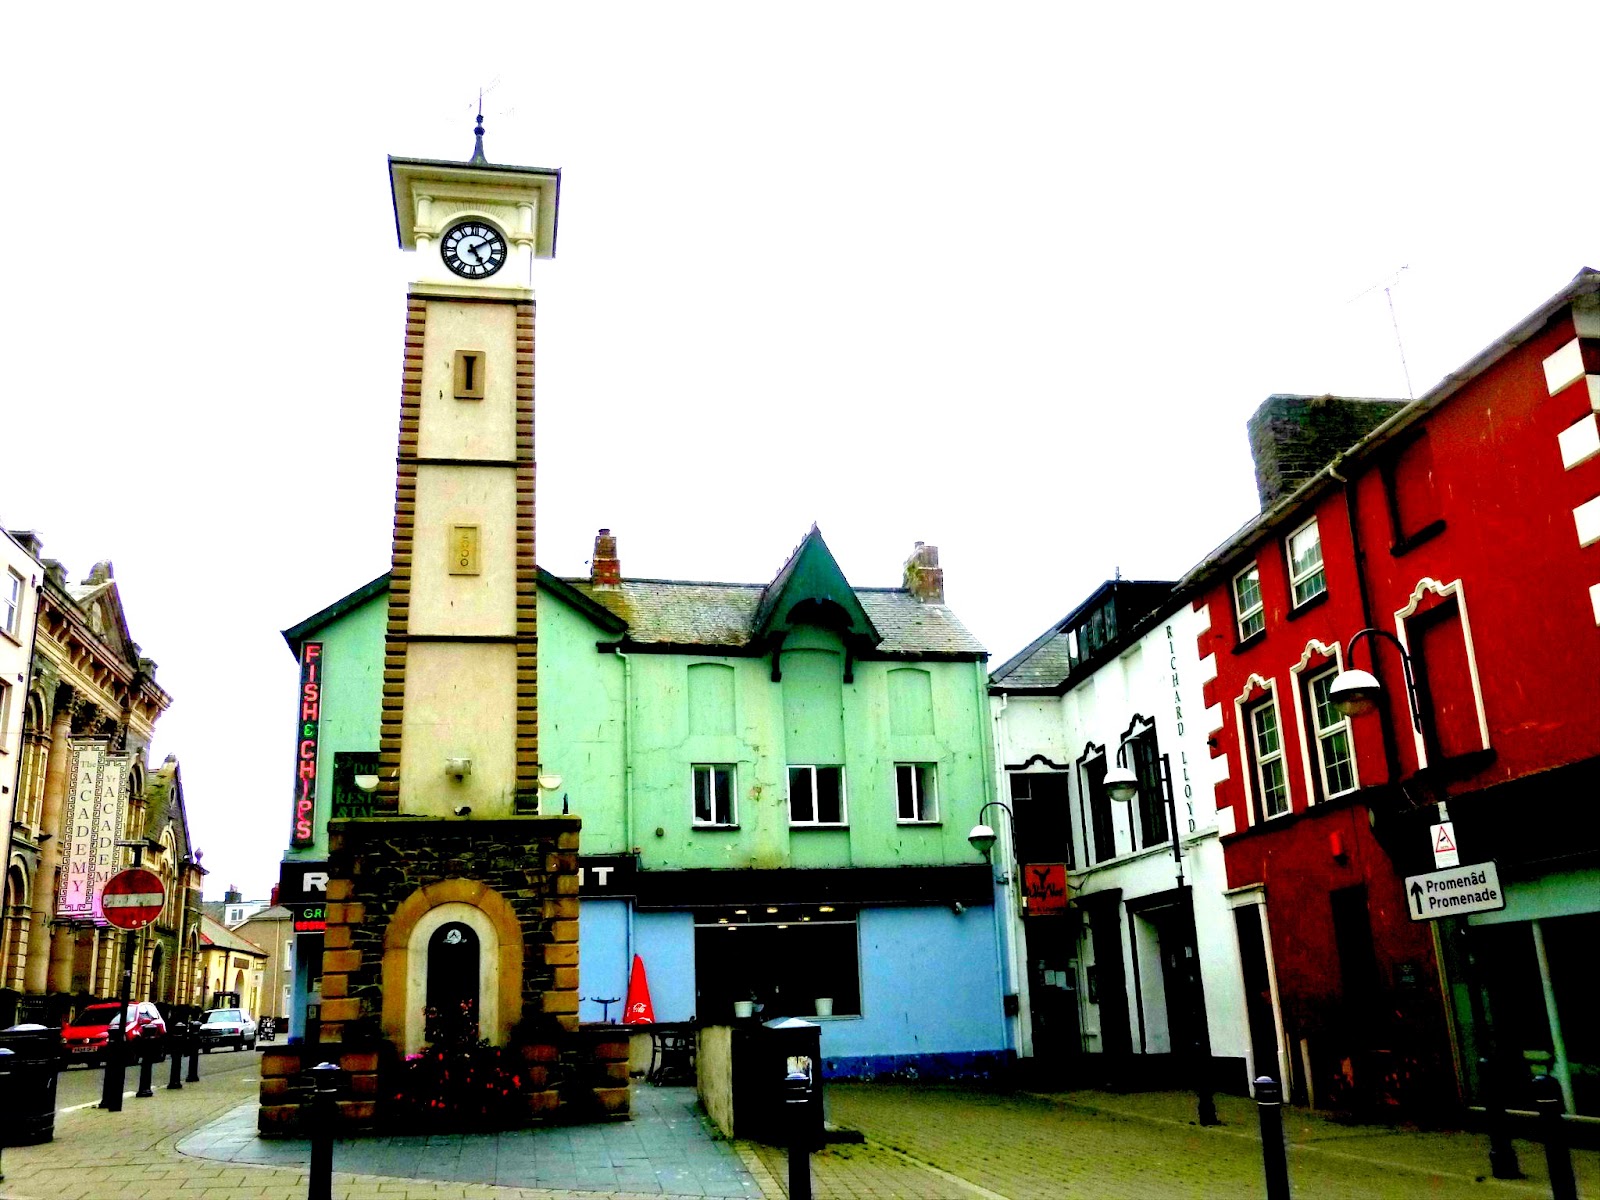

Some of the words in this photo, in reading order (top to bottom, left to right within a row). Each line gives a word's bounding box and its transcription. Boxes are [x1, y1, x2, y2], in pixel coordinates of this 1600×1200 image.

[302, 645, 321, 721] FISH
[80, 760, 98, 768] The
[1166, 625, 1184, 736] RICHARD
[1181, 752, 1196, 833] LLOYD
[71, 772, 93, 892] ACADEMY
[296, 741, 315, 840] CHIPS
[95, 786, 115, 884] ACADEM
[1426, 871, 1486, 893] Promenâd
[1429, 888, 1497, 909] Promenade
